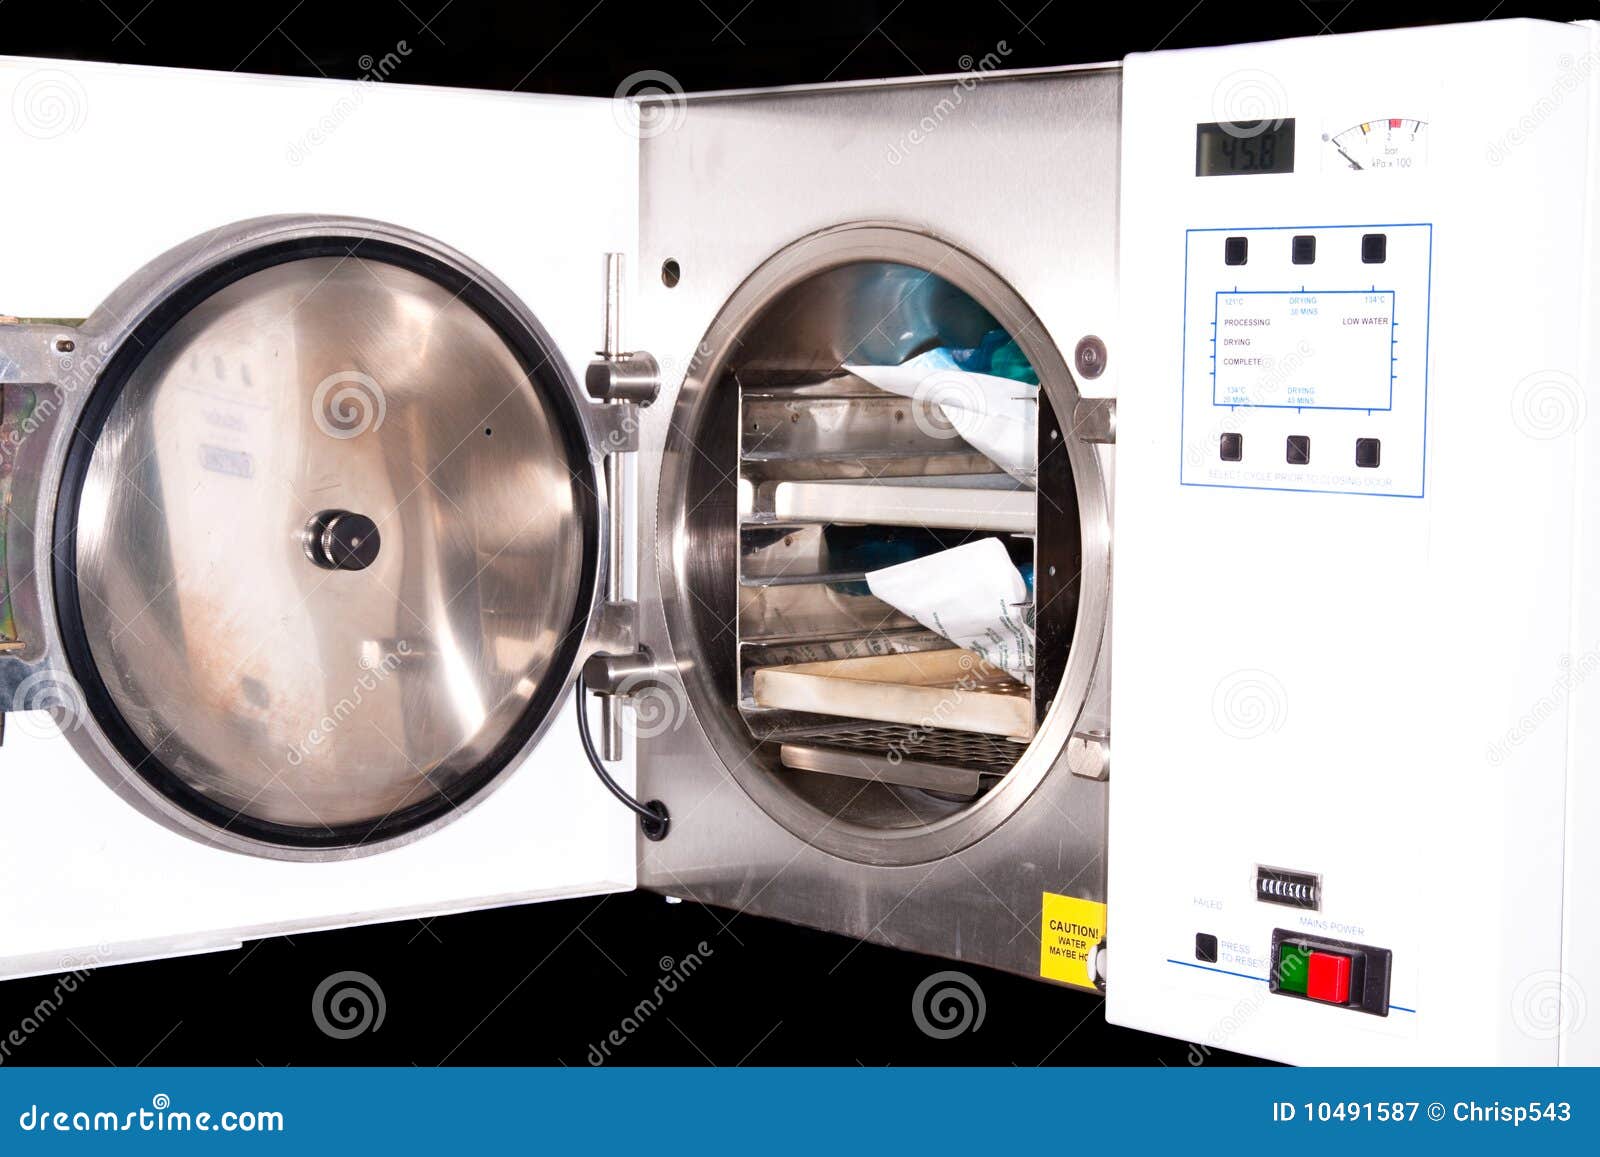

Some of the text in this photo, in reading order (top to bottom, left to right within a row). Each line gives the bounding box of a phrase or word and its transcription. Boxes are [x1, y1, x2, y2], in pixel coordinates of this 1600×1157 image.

[1387, 133, 1392, 141] 2
[1409, 134, 1415, 142] 3
[1384, 145, 1399, 155] bar
[1395, 158, 1412, 168] 100
[1289, 296, 1317, 305] DRYING
[1300, 307, 1319, 316] MINS
[1224, 318, 1271, 327] PROCESSING
[1342, 317, 1389, 326] LOW WATER
[1223, 338, 1251, 346] DRYING
[1223, 358, 1262, 366] COMPLETE
[1287, 386, 1315, 395] DRYING
[1296, 397, 1315, 405] MINS
[1243, 471, 1273, 482] CYCLE
[1193, 896, 1223, 911] FAILED
[1049, 919, 1099, 940] CAUTION!
[1299, 916, 1366, 936] MAINS POWER
[1058, 936, 1087, 950] WATER
[1221, 940, 1250, 954] PRESS
[1049, 946, 1077, 959] MAYBE
[1221, 953, 1235, 963] TO
